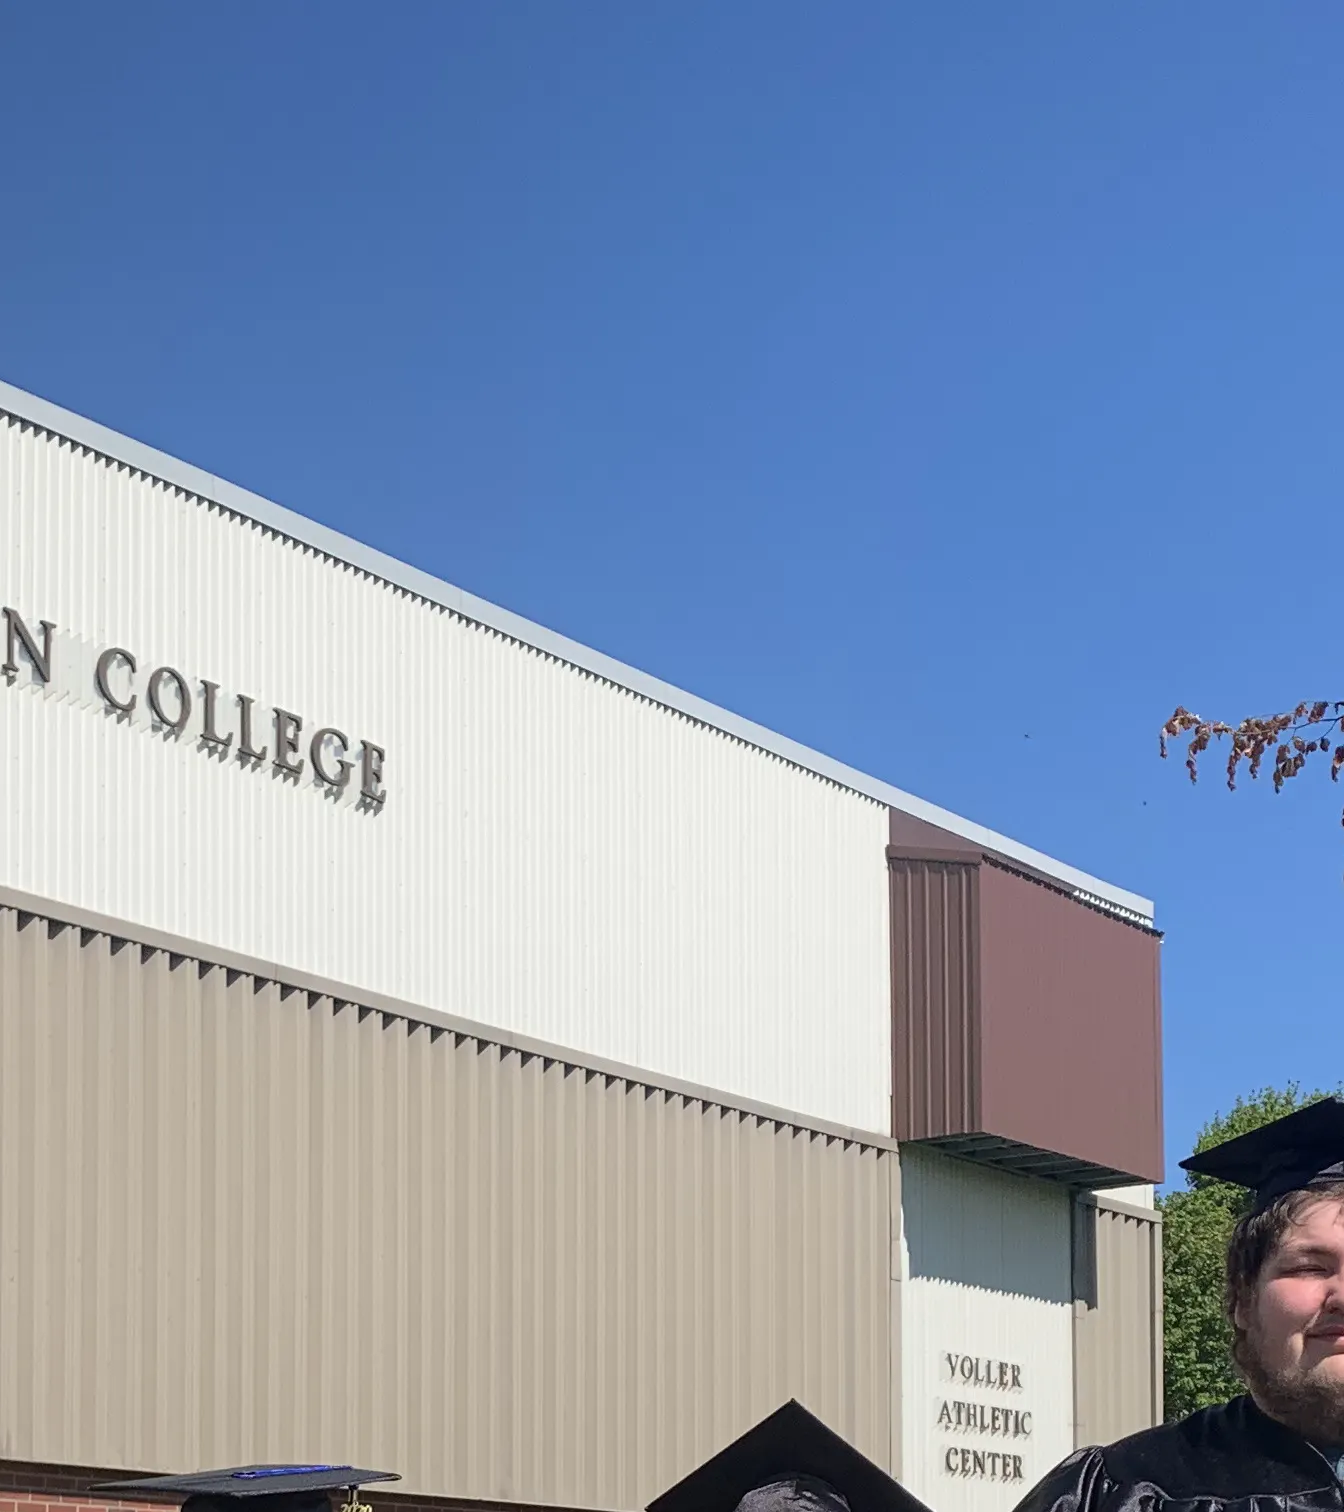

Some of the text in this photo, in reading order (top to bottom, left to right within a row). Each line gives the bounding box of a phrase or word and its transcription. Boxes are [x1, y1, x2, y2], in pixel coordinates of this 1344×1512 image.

[95, 647, 388, 803] COLLEGE
[945, 1353, 1023, 1389] VOLLER
[937, 1400, 1033, 1436] ATHLETIC
[944, 1447, 1024, 1480] CENTER
